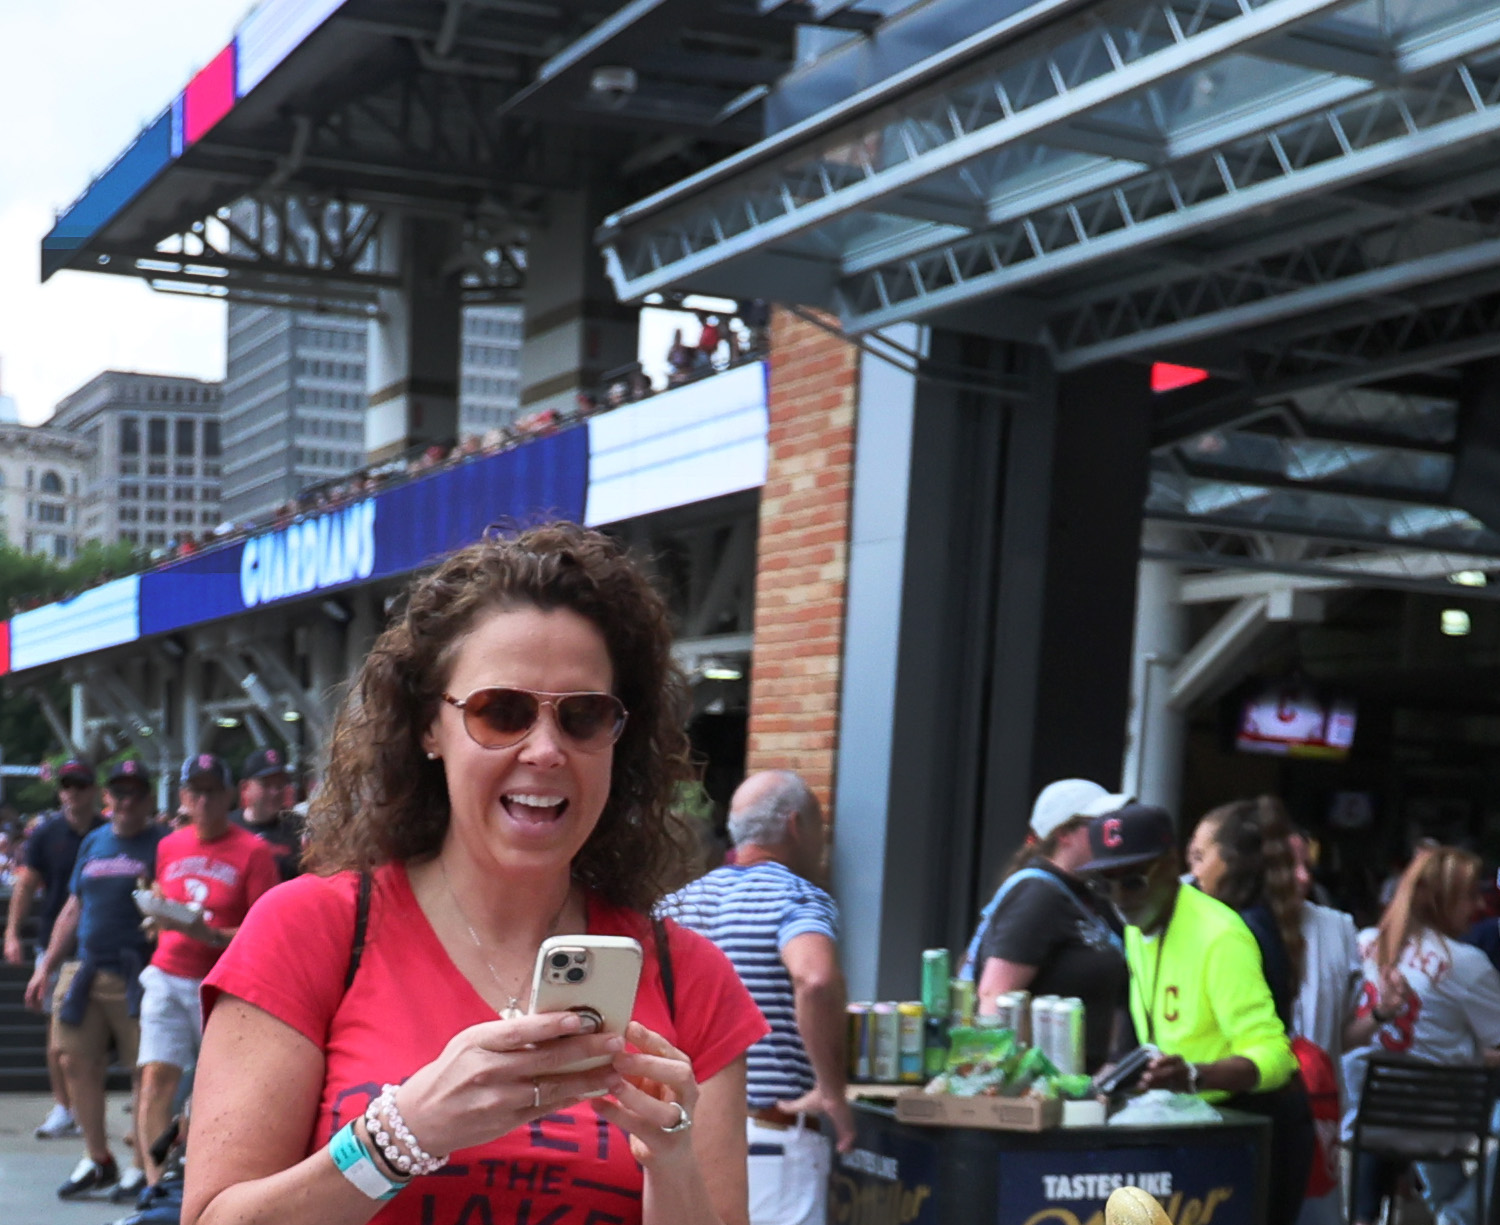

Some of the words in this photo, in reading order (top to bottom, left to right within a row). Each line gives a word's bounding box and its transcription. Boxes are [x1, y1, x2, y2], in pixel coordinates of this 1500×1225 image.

[1103, 818, 1123, 847] C
[1164, 985, 1179, 1022] C
[478, 1159, 568, 1195] THE
[1041, 1174, 1124, 1199] TASTES
